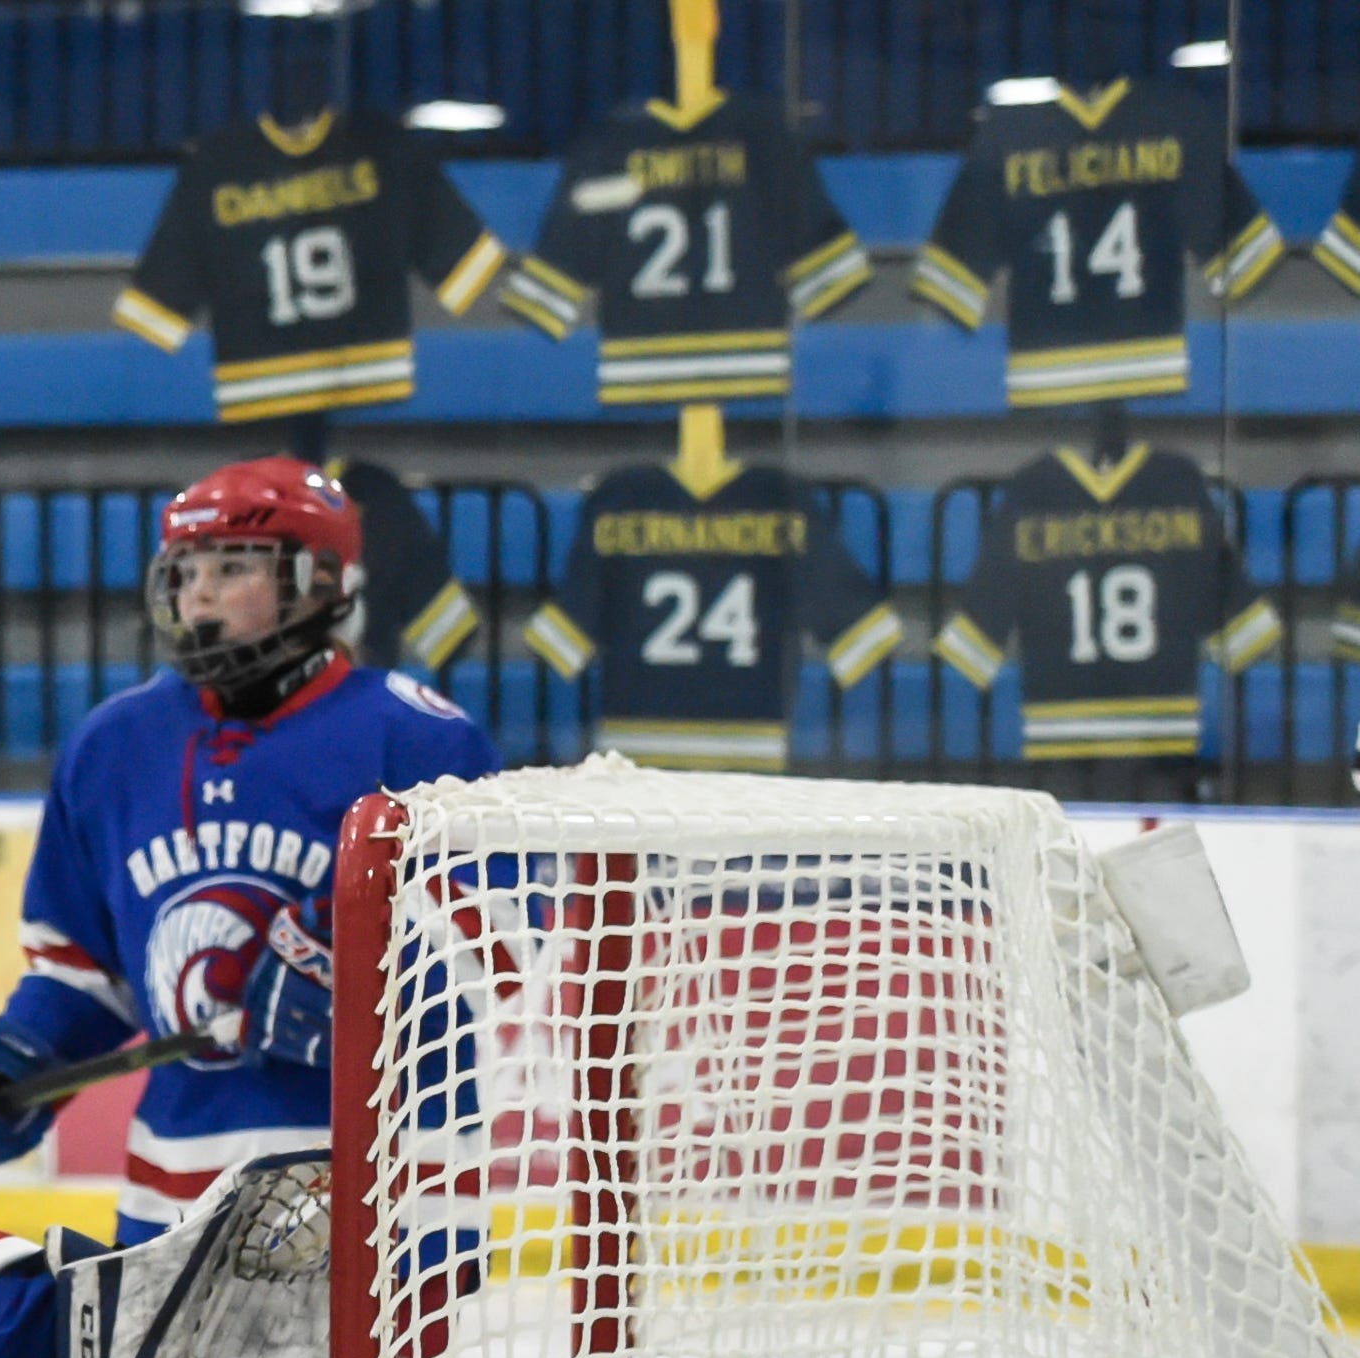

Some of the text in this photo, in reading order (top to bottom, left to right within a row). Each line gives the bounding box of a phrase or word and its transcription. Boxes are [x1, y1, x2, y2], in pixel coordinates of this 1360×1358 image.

[261, 226, 357, 325] 19
[627, 202, 735, 299] 21
[1048, 202, 1146, 304] 14
[642, 570, 759, 668] 24
[1065, 563, 1158, 665] 18
[126, 820, 332, 898] HARTFORD
